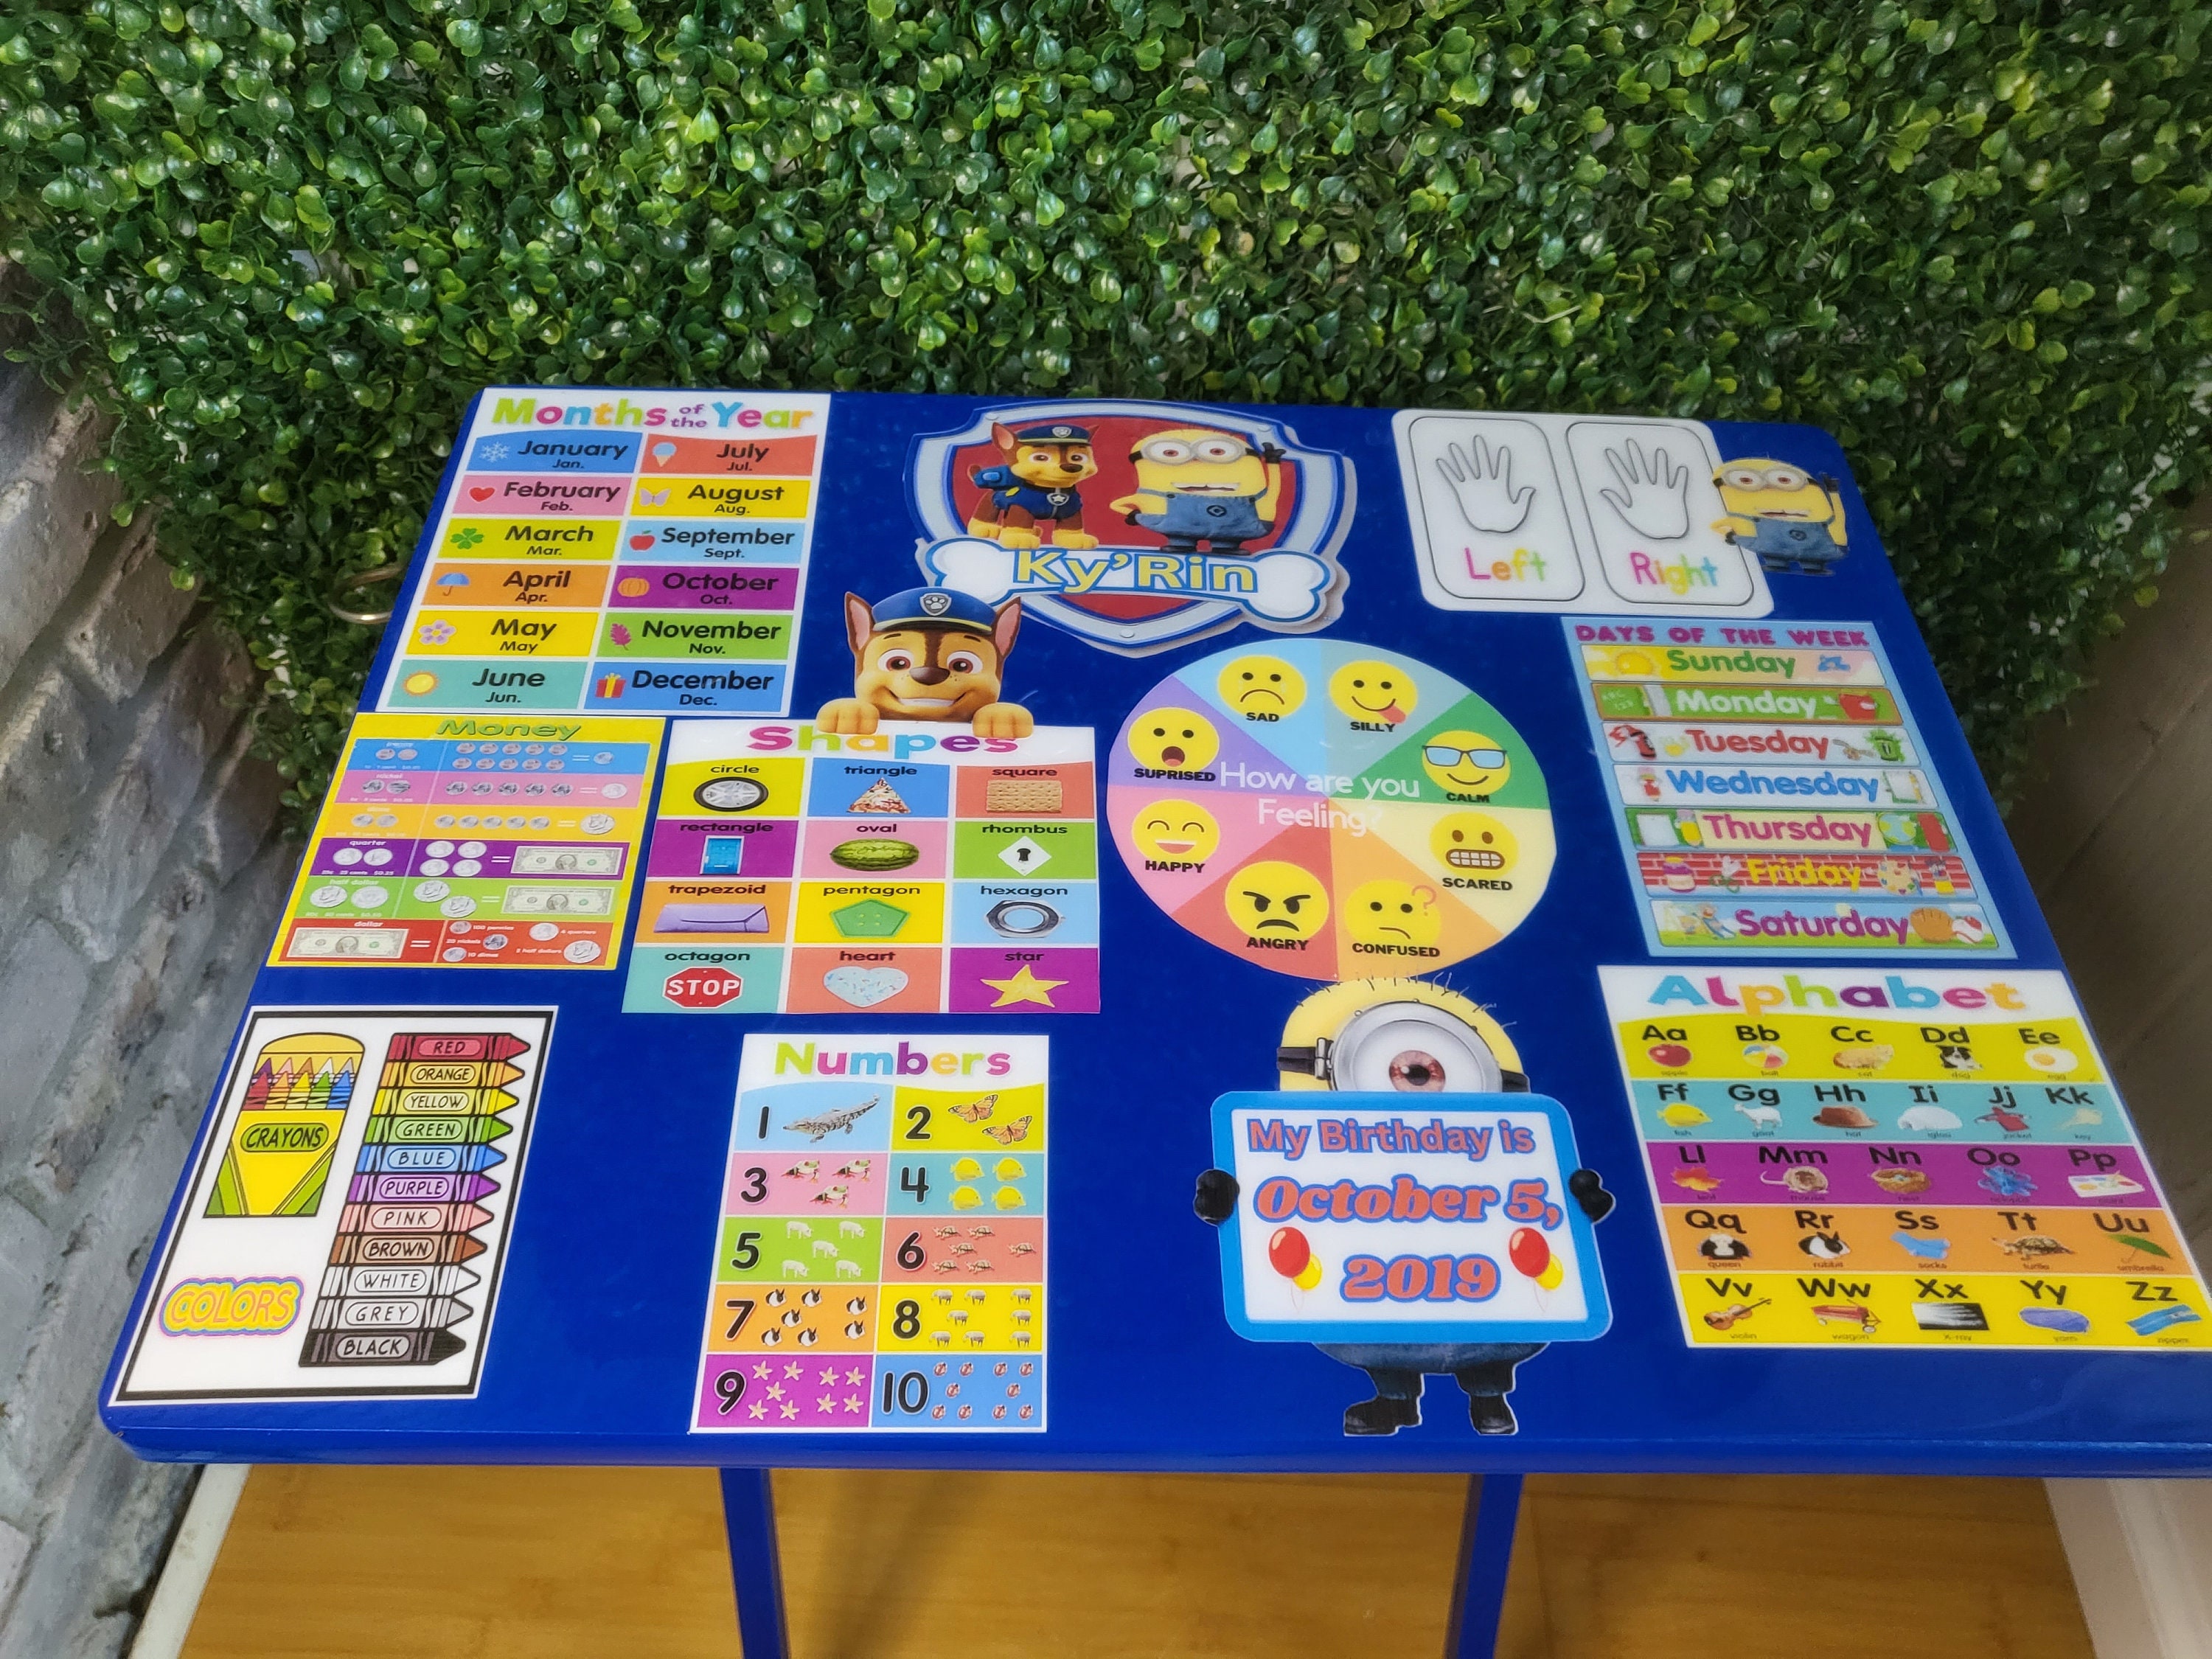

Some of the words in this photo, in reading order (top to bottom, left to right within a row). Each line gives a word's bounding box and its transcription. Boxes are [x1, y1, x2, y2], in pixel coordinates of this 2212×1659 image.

[492, 398, 666, 427] Months
[679, 403, 703, 414] of
[712, 403, 813, 428] Year
[670, 417, 707, 428] the
[518, 441, 627, 459] January
[716, 444, 769, 462] July
[552, 459, 585, 469] Jan.
[726, 462, 754, 471] Jul.
[504, 482, 621, 501] February
[687, 485, 785, 504] August
[540, 501, 574, 511] Feb.
[714, 504, 750, 514] Aug.
[504, 526, 594, 541] March
[661, 528, 795, 547] September
[526, 546, 563, 556] Mar.
[703, 549, 744, 560] Sept.
[1464, 548, 1546, 581] Left
[1629, 552, 1718, 595] Right
[502, 571, 571, 590] April
[663, 574, 779, 591] October
[515, 593, 548, 603] Apr.
[700, 595, 733, 605] Oct.
[490, 619, 557, 639] May
[641, 621, 782, 641] November
[1576, 625, 1654, 642] DAYS
[1669, 627, 1705, 644] OF
[1719, 627, 1776, 645] THE
[1787, 630, 1869, 647] WEEK
[500, 641, 538, 653] May
[689, 644, 726, 654] Nov.
[1666, 650, 1795, 678] Sunday
[471, 669, 545, 687] June
[632, 671, 774, 690] December
[485, 692, 522, 703] Jun.
[680, 695, 717, 706] Dec.
[1677, 690, 1818, 719] Monday
[1245, 712, 1279, 723] SAD
[435, 720, 582, 740] Money
[1350, 721, 1395, 733] SILLY
[748, 726, 1020, 759] Shapes
[1685, 729, 1829, 760] Tuesday
[710, 765, 759, 774] circle
[844, 766, 917, 777] triangle
[991, 768, 1058, 779] square
[1133, 768, 1216, 782] SUPRISED
[1220, 762, 1297, 789] How
[1308, 771, 1353, 794] are
[1362, 776, 1420, 800] you
[1665, 770, 1879, 802] Wednesday
[1446, 793, 1490, 804] CALM
[1257, 799, 1382, 835] Feeling?
[679, 822, 773, 835] rectangle
[856, 824, 897, 833] oval
[982, 824, 1068, 835] rhombus
[1703, 814, 1871, 848] Thursday
[1144, 860, 1205, 874] HAPPY
[1746, 858, 1863, 892] Friday
[669, 885, 766, 897] trapezoid
[823, 886, 921, 898] pentagon
[980, 886, 1069, 898] hexagon
[1441, 877, 1514, 891] SCARED
[1734, 908, 1909, 945] Saturday
[1246, 938, 1310, 951] ANGRY
[1352, 943, 1441, 958] CONFUSED
[664, 951, 751, 963] octagon
[839, 951, 896, 961] heart
[1005, 951, 1045, 961] star
[666, 979, 741, 997] STOP
[1648, 975, 2030, 1017] Alphabet
[1642, 1025, 1688, 1041] Aa
[1735, 1026, 1780, 1041] Bb
[1830, 1026, 1874, 1042] Cc
[1920, 1026, 1970, 1043] Dd
[2018, 1028, 2060, 1044] Ee
[432, 1040, 466, 1054] RED
[774, 1042, 1012, 1076] Numbers
[415, 1066, 471, 1082] ORANGE
[409, 1094, 464, 1109] YELLOW
[1658, 1084, 1688, 1101] Ff
[1728, 1084, 1781, 1105] Gg
[1814, 1084, 1866, 1102] Hh
[1908, 1085, 1938, 1103] Ii
[1989, 1086, 2017, 1108] Jj
[2045, 1087, 2095, 1105] Kk
[400, 1122, 457, 1137] GREEN
[757, 1105, 770, 1139] 1
[904, 1106, 932, 1139] 2
[244, 1127, 325, 1150] CRAYONS
[1247, 1119, 1312, 1160] My
[1318, 1119, 1492, 1161] Birthday
[1498, 1120, 1537, 1153] is
[399, 1151, 445, 1166] BLUE
[1679, 1145, 1706, 1164] Ll
[1758, 1146, 1828, 1164] Mm
[1868, 1147, 1922, 1164] Nn
[1967, 1148, 2021, 1166] Oo
[2068, 1149, 2117, 1171] Pp
[383, 1180, 444, 1196] PURPLE
[740, 1167, 768, 1203] 3
[900, 1166, 930, 1203] 4
[1253, 1173, 1500, 1223] October
[1503, 1177, 1565, 1230] 5,
[384, 1211, 429, 1225] PINK
[1685, 1210, 1747, 1234] Qq
[1795, 1210, 1834, 1228] Rr
[1895, 1211, 1940, 1231] Ss
[1997, 1211, 2037, 1231] Tt
[2093, 1213, 2150, 1233] Uu
[369, 1241, 430, 1256] BROWN
[731, 1232, 761, 1270] 5
[897, 1231, 925, 1270] 6
[364, 1273, 421, 1289] WHITE
[1340, 1254, 1501, 1303] 2019
[1705, 1277, 1753, 1297] Vv
[1797, 1278, 1871, 1297] Ww
[1914, 1279, 1969, 1298] Xx
[2020, 1280, 2067, 1305] Yy
[2125, 1281, 2178, 1301] Zz
[171, 1289, 295, 1324] COLORS
[355, 1304, 408, 1321] GREY
[725, 1300, 757, 1340] 7
[892, 1299, 920, 1340] 8
[341, 1338, 402, 1355] BLACK
[714, 1370, 746, 1414] 9
[881, 1370, 929, 1414] 10
